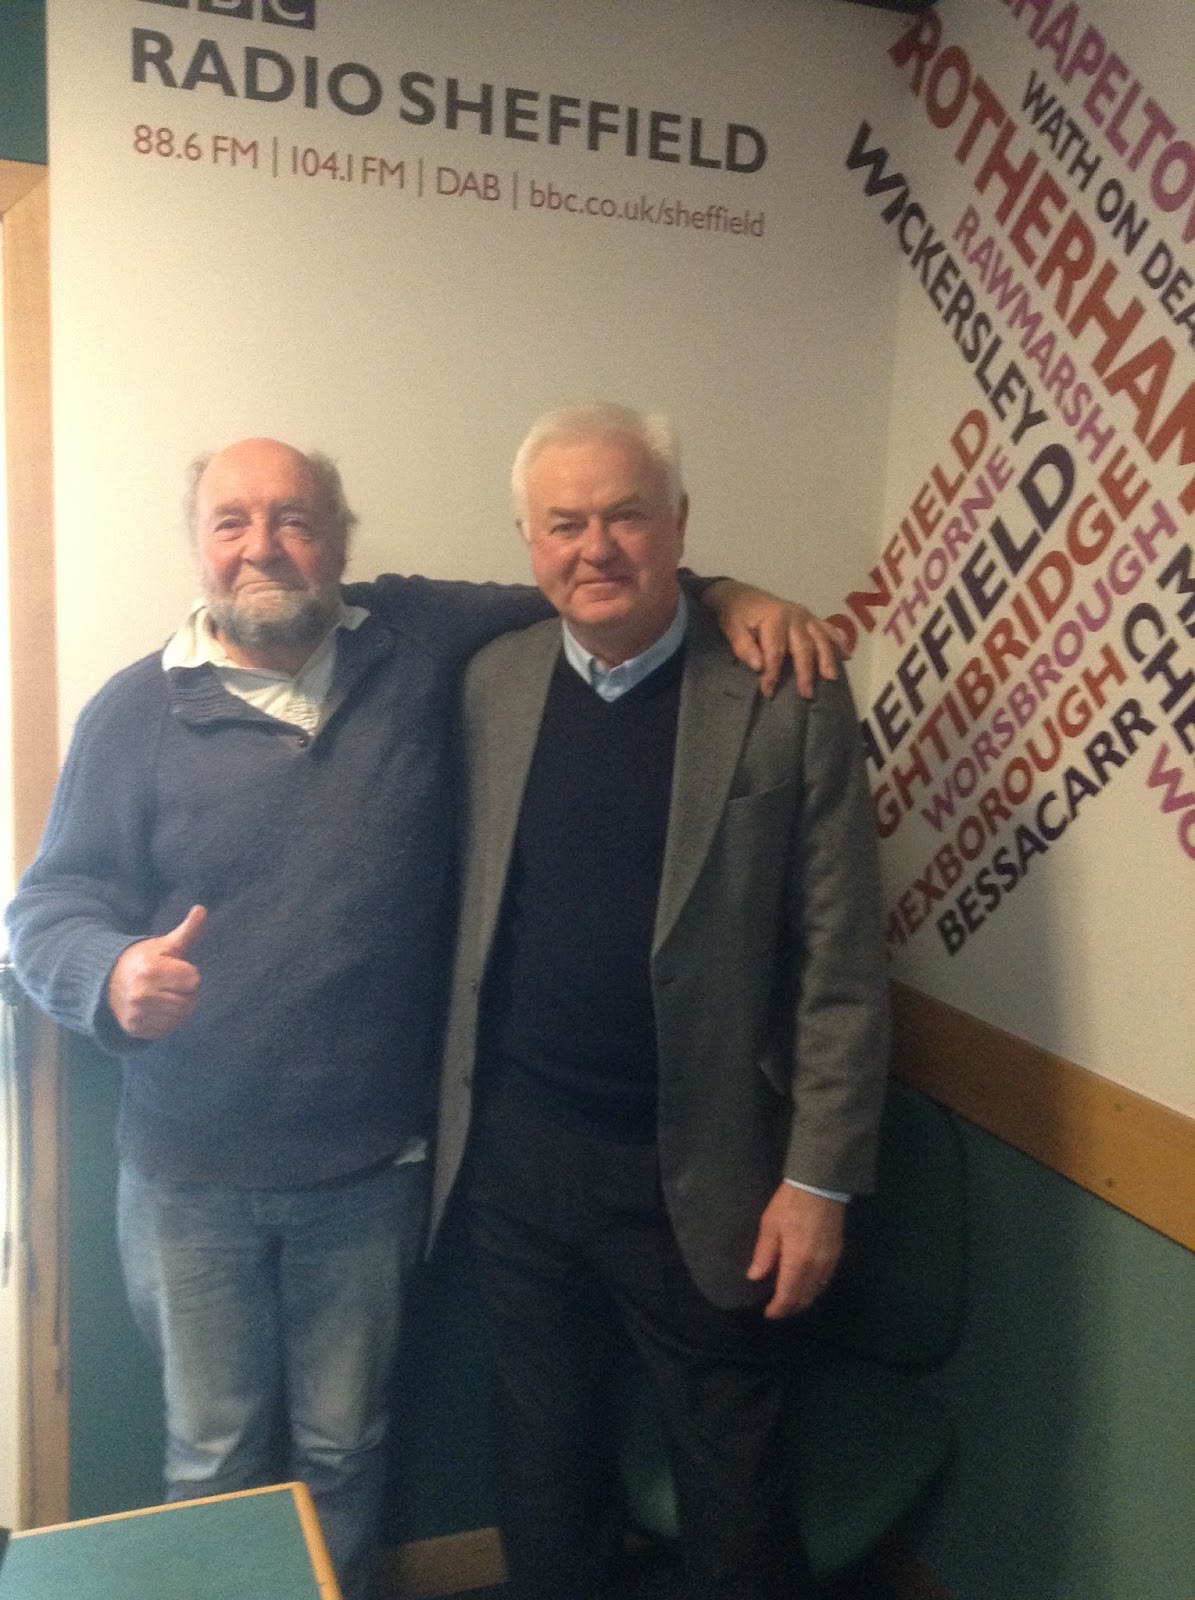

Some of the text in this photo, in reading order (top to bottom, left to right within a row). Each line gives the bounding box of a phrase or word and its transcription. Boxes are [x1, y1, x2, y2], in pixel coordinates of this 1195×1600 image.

[131, 27, 768, 174] RADIO SHEFFIELD
[133, 124, 765, 238] 88.6 FM 104.1 FM DAB bbc.co.uk/sheffield
[1004, 0, 1195, 245] HAPELTO
[1020, 69, 1102, 192] WATH
[1096, 178, 1149, 256] ON
[846, 118, 1049, 446] WICKERSLEY
[953, 203, 1116, 464] RAWMARSH
[873, 443, 1152, 839] GHTIBRIDGE
[883, 446, 1015, 647] THORNE
[921, 499, 1179, 832] WORSBROUGH
[935, 698, 1158, 956] BESSACARR
